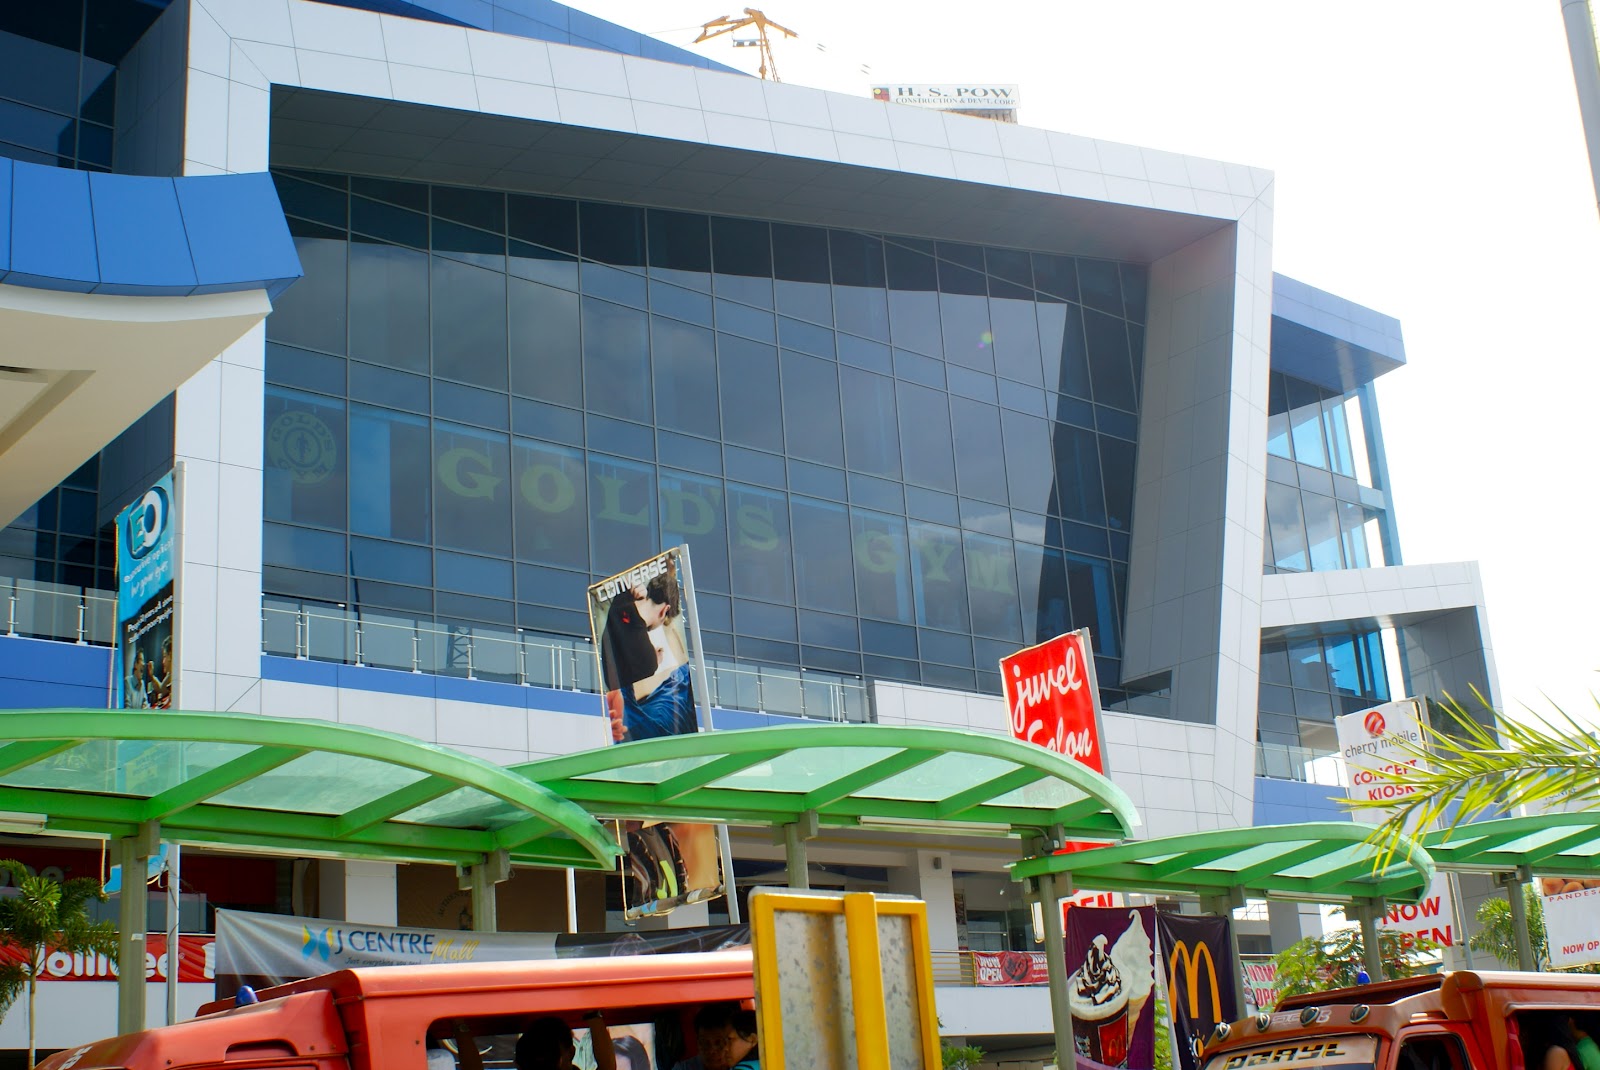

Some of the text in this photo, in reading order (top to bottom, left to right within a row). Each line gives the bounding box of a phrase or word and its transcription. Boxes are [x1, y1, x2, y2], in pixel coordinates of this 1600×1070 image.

[895, 97, 957, 105] CONSTRUCTION
[898, 87, 1013, 98] H. S. POW
[437, 447, 1015, 596] GOLD'S GYM
[597, 556, 668, 602] CONVERSE
[1013, 646, 1083, 733] juvel
[1345, 730, 1418, 758] cherry mobile
[1549, 889, 1600, 902] PANDES
[1382, 896, 1441, 925] NOW
[20, 938, 179, 978] Jolliee
[348, 930, 435, 954] CENTRE
[430, 938, 480, 961] Mall
[1563, 943, 1584, 954] NOW
[980, 967, 1004, 982] OPEN
